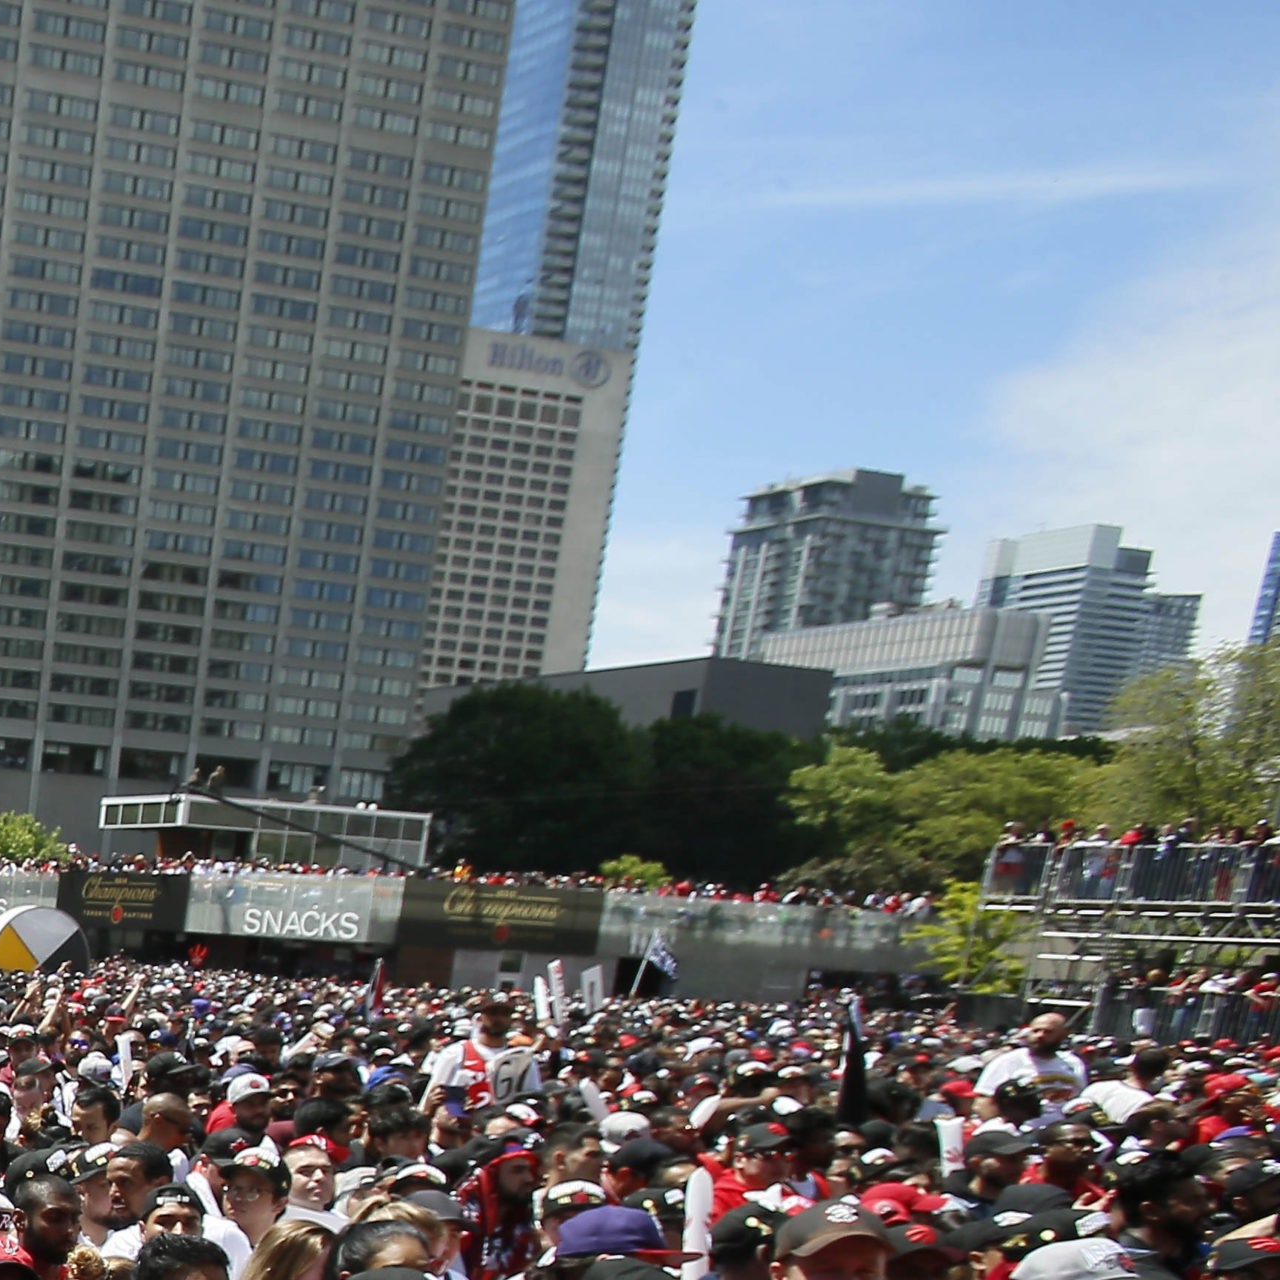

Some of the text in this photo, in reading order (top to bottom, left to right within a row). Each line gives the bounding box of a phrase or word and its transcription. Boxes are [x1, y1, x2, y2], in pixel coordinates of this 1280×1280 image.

[488, 342, 565, 376] Hilton
[81, 877, 159, 901] Champions
[443, 886, 561, 922] Chmpions
[243, 907, 359, 938] SNACKS
